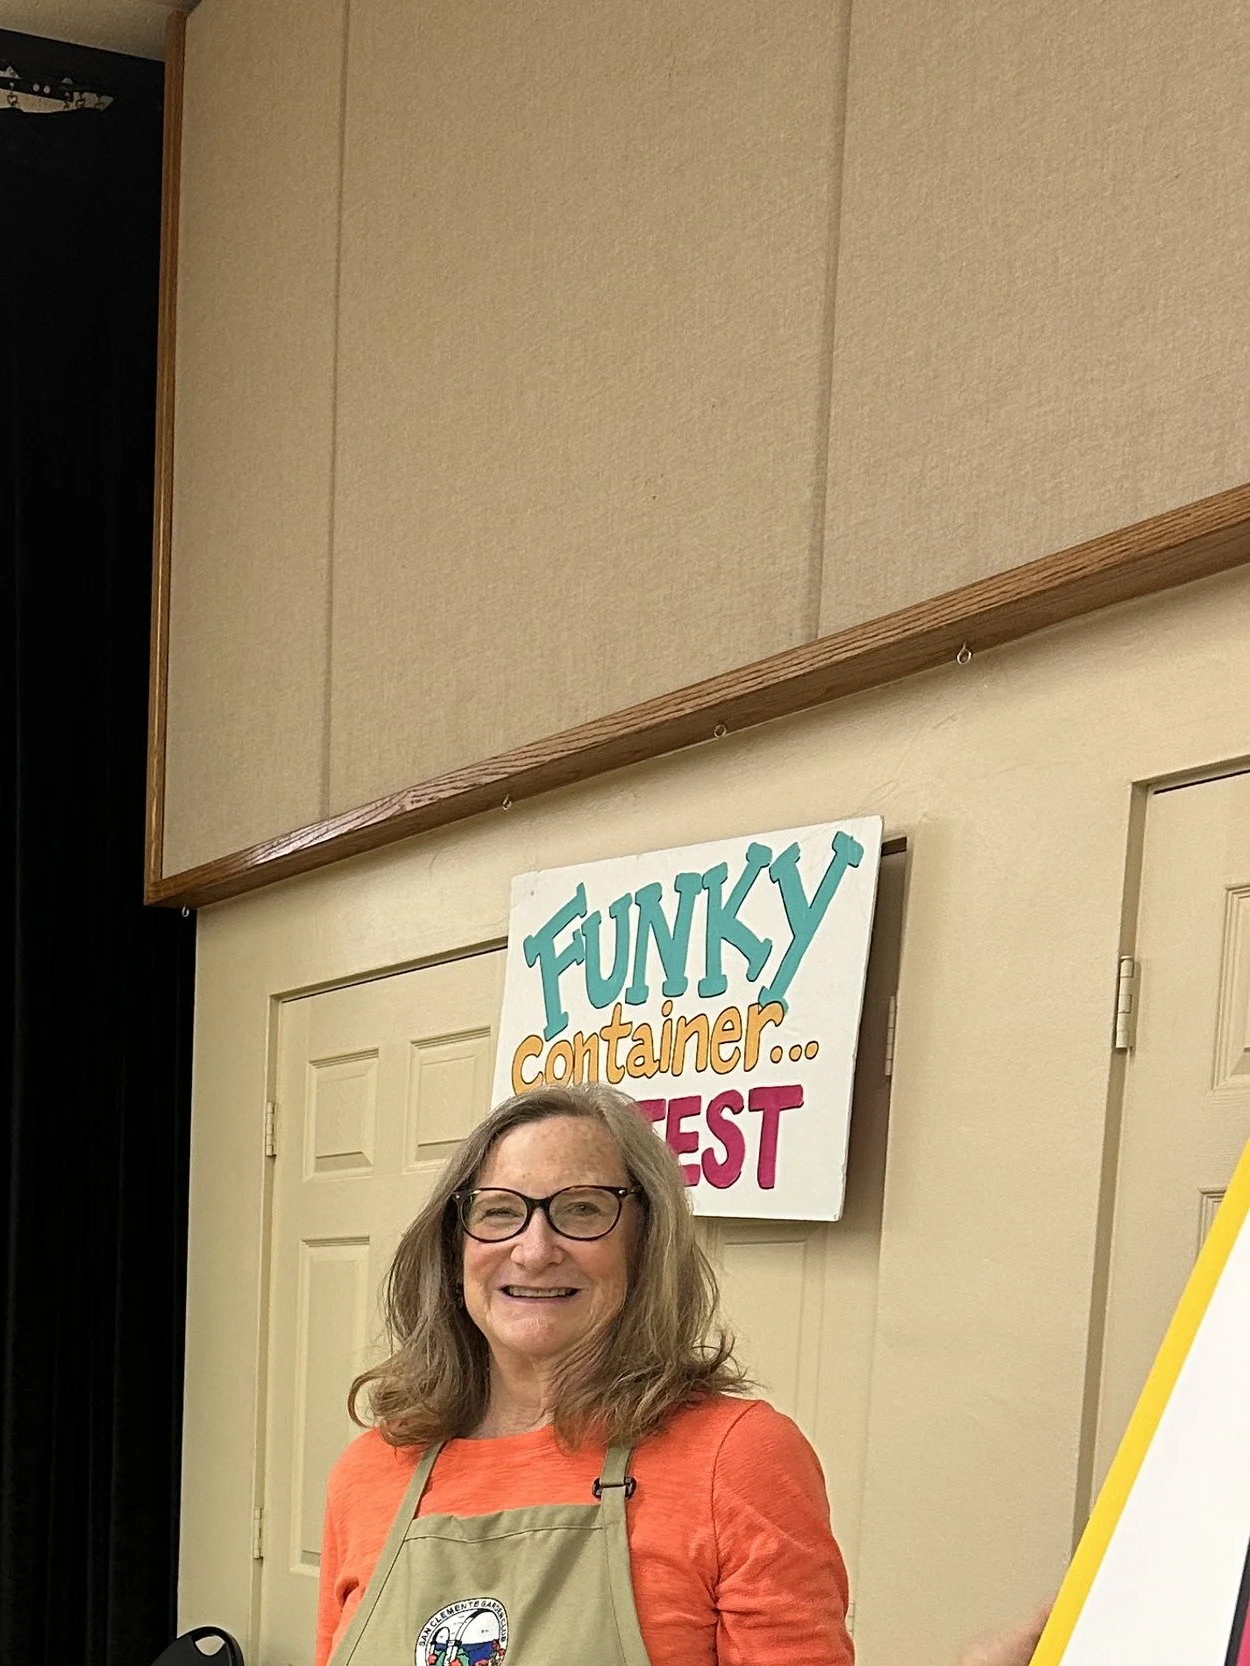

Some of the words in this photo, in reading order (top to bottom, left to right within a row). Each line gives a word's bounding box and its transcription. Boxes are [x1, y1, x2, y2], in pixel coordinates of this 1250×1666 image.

[523, 830, 865, 1042] FUNKY
[418, 1627, 432, 1647] SAN
[430, 1600, 480, 1628] CLEMENTE
